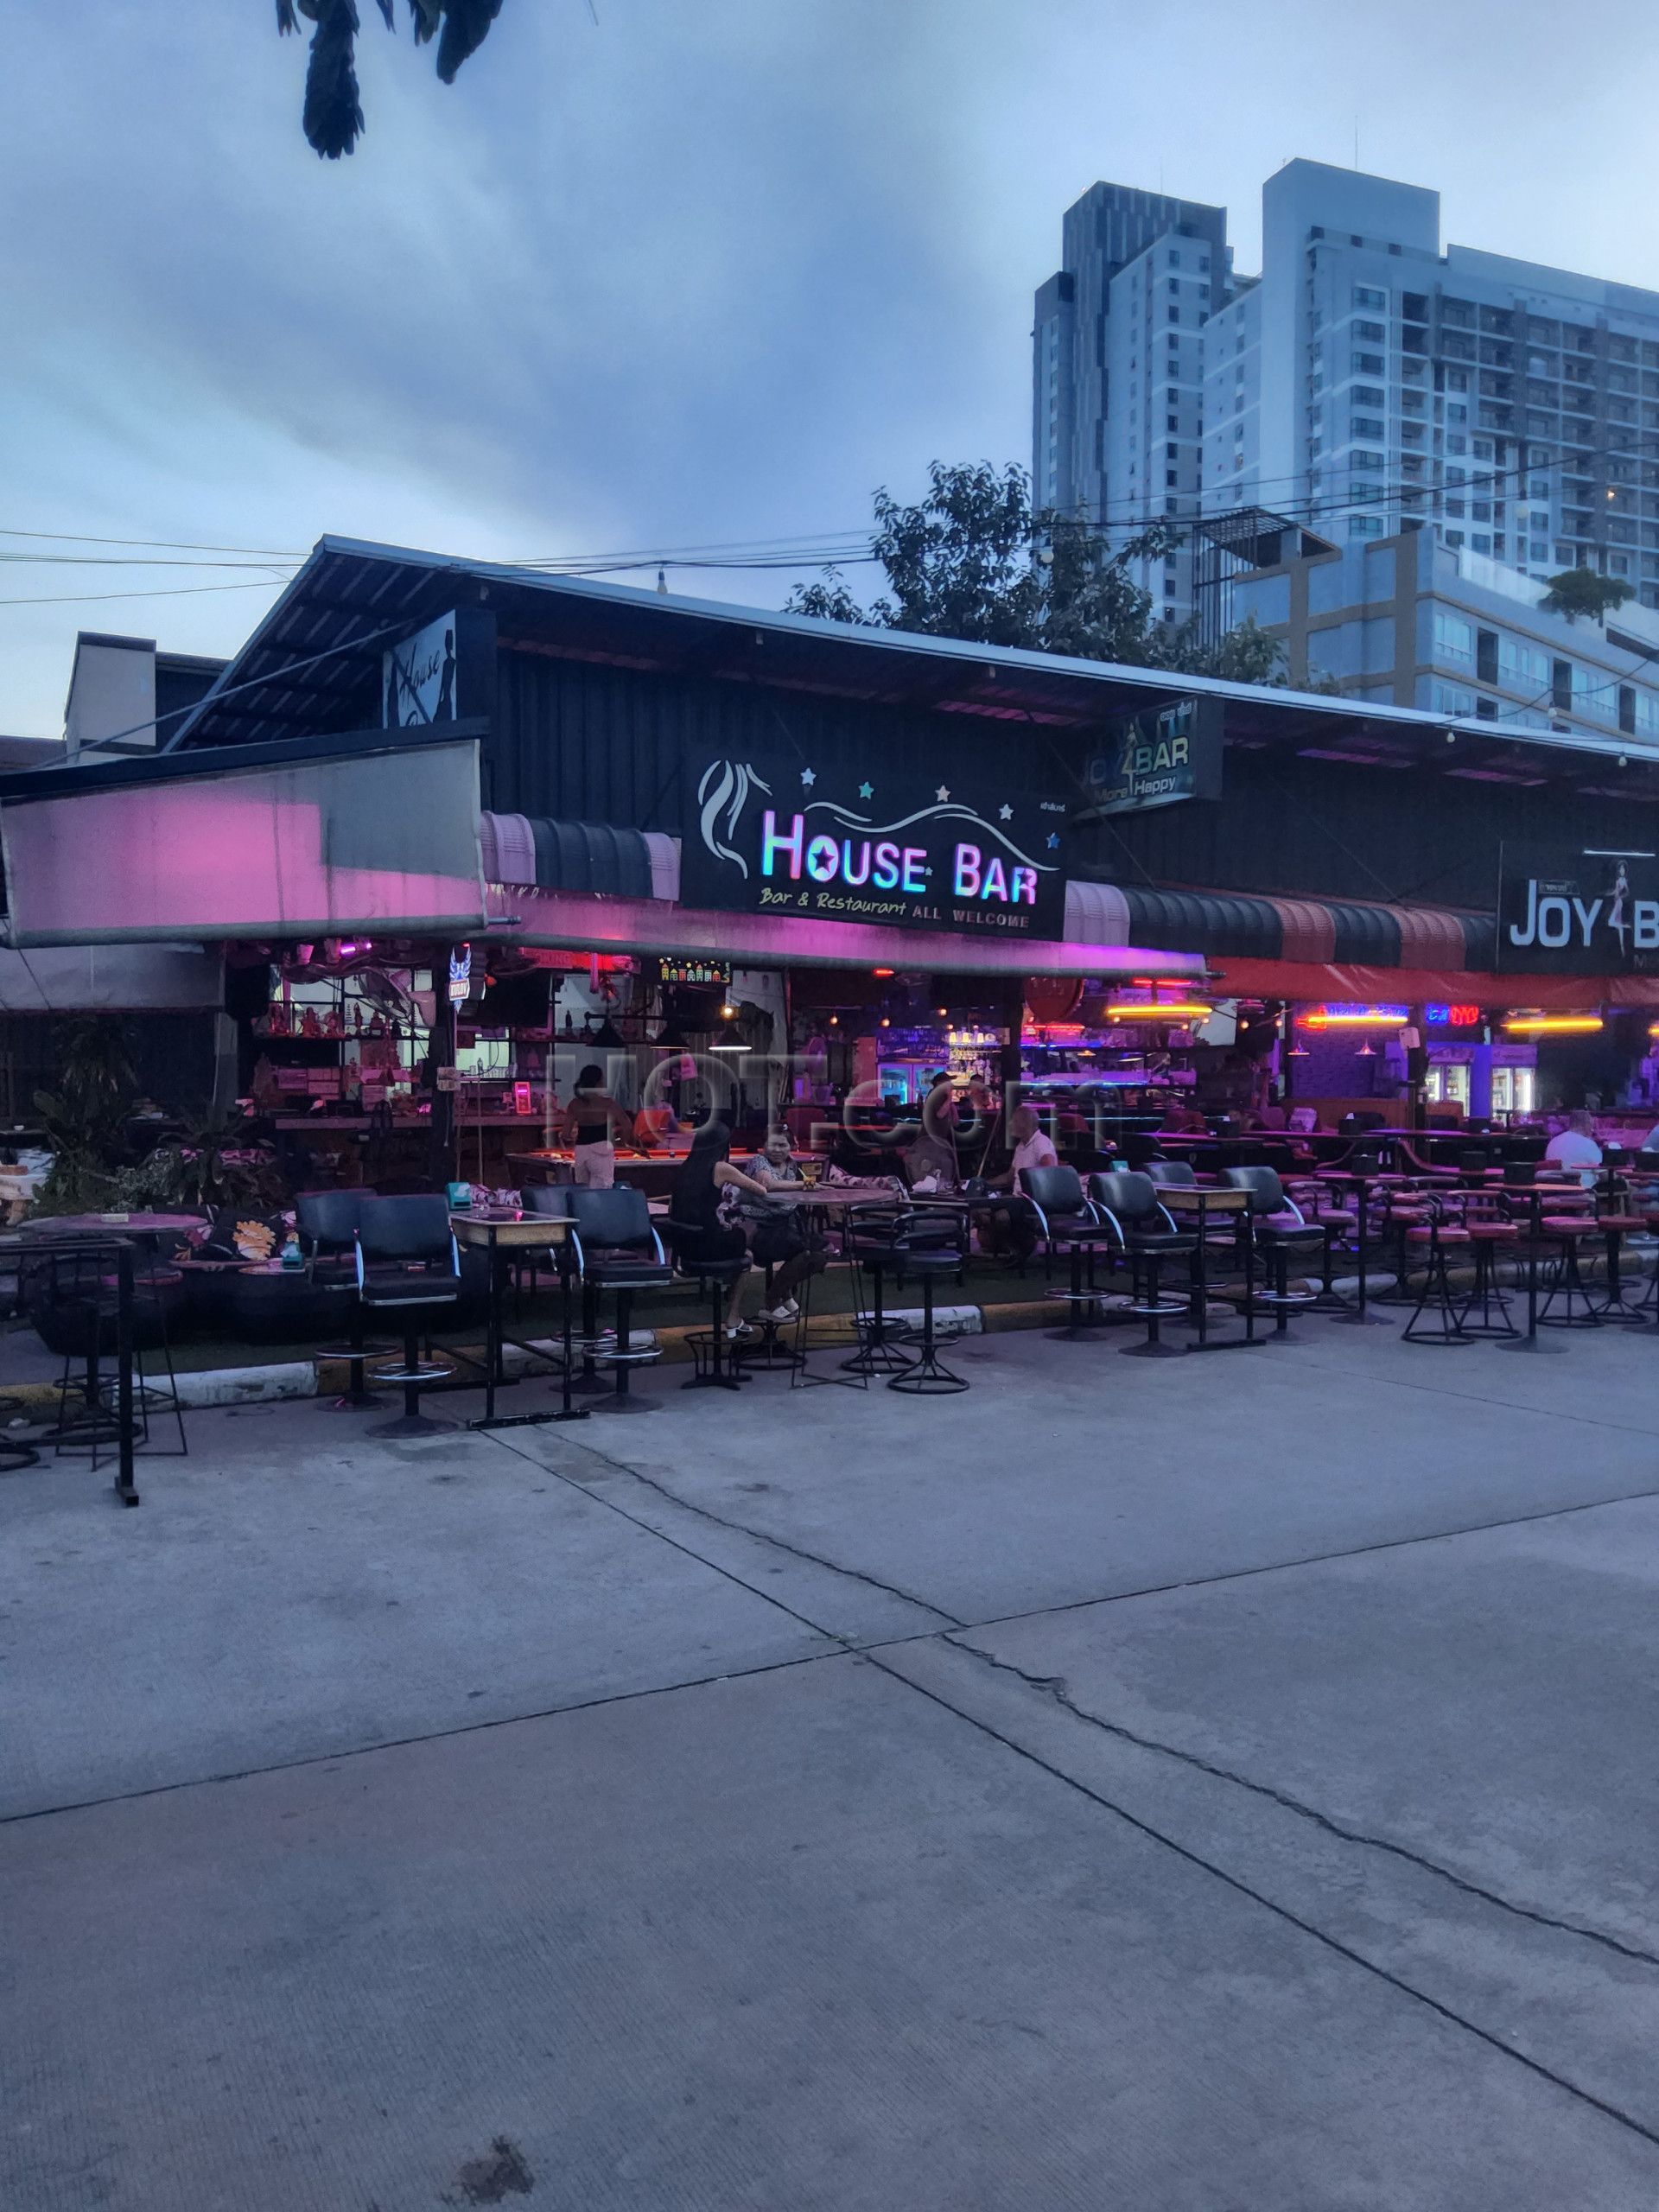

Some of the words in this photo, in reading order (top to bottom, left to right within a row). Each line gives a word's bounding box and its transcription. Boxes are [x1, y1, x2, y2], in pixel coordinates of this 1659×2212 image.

[1135, 736, 1189, 775] BAR
[1134, 777, 1177, 796] Happy
[761, 810, 927, 893] HOUSE
[953, 842, 1037, 905] BAR
[759, 887, 792, 906] Bar
[798, 891, 809, 907] &
[816, 891, 907, 916] Restaurant
[912, 904, 943, 921] ALL
[952, 908, 1032, 929] WELCOME
[1510, 879, 1604, 948] JOY
